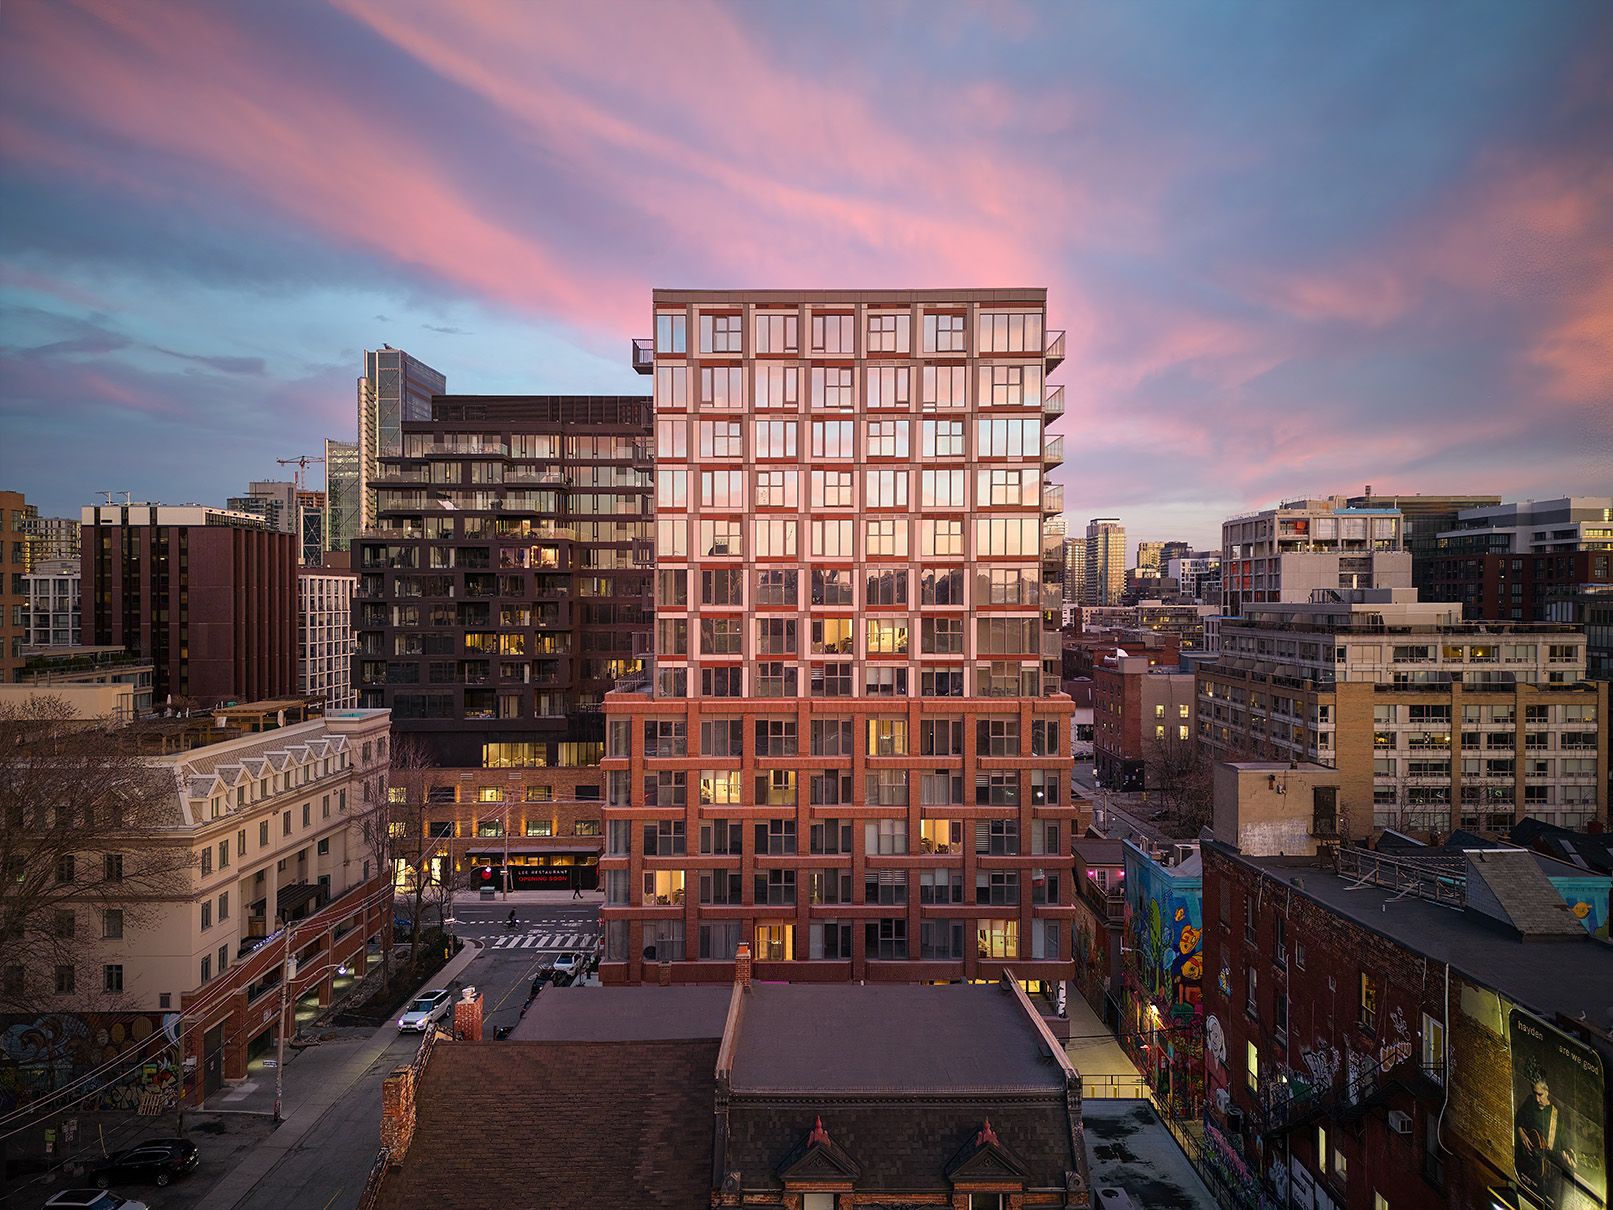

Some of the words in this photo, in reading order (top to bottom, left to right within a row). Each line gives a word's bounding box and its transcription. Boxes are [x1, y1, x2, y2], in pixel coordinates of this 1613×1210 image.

[1518, 1020, 1543, 1040] hayden
[1559, 1045, 1570, 1057] are
[1571, 1052, 1582, 1064] we
[1583, 1060, 1599, 1075] good
